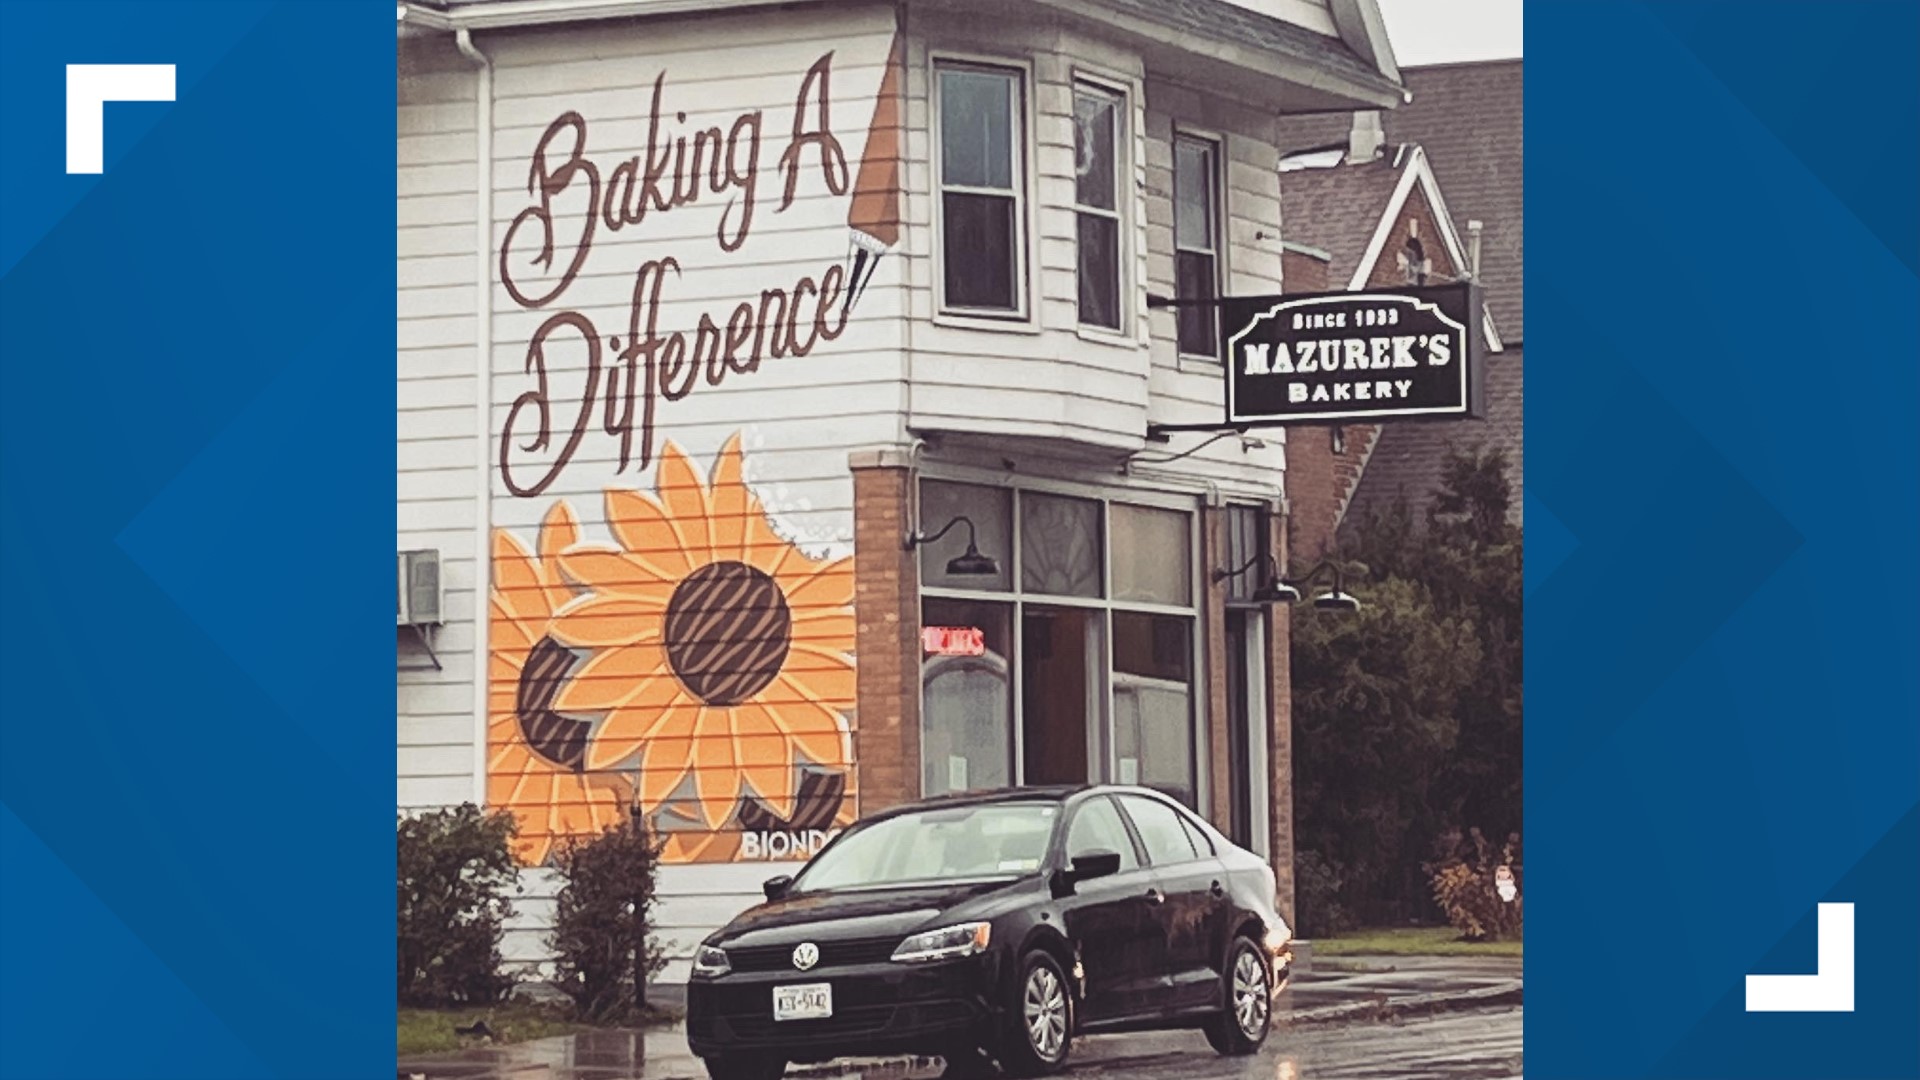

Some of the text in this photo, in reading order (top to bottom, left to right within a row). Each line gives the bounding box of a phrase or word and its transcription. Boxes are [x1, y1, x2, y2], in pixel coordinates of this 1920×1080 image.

[500, 49, 850, 308] Baking A
[1354, 308, 1399, 327] 1933
[1243, 333, 1451, 376] MAZUREK'S
[500, 256, 848, 498] Difference
[1288, 379, 1413, 404] BAKERY
